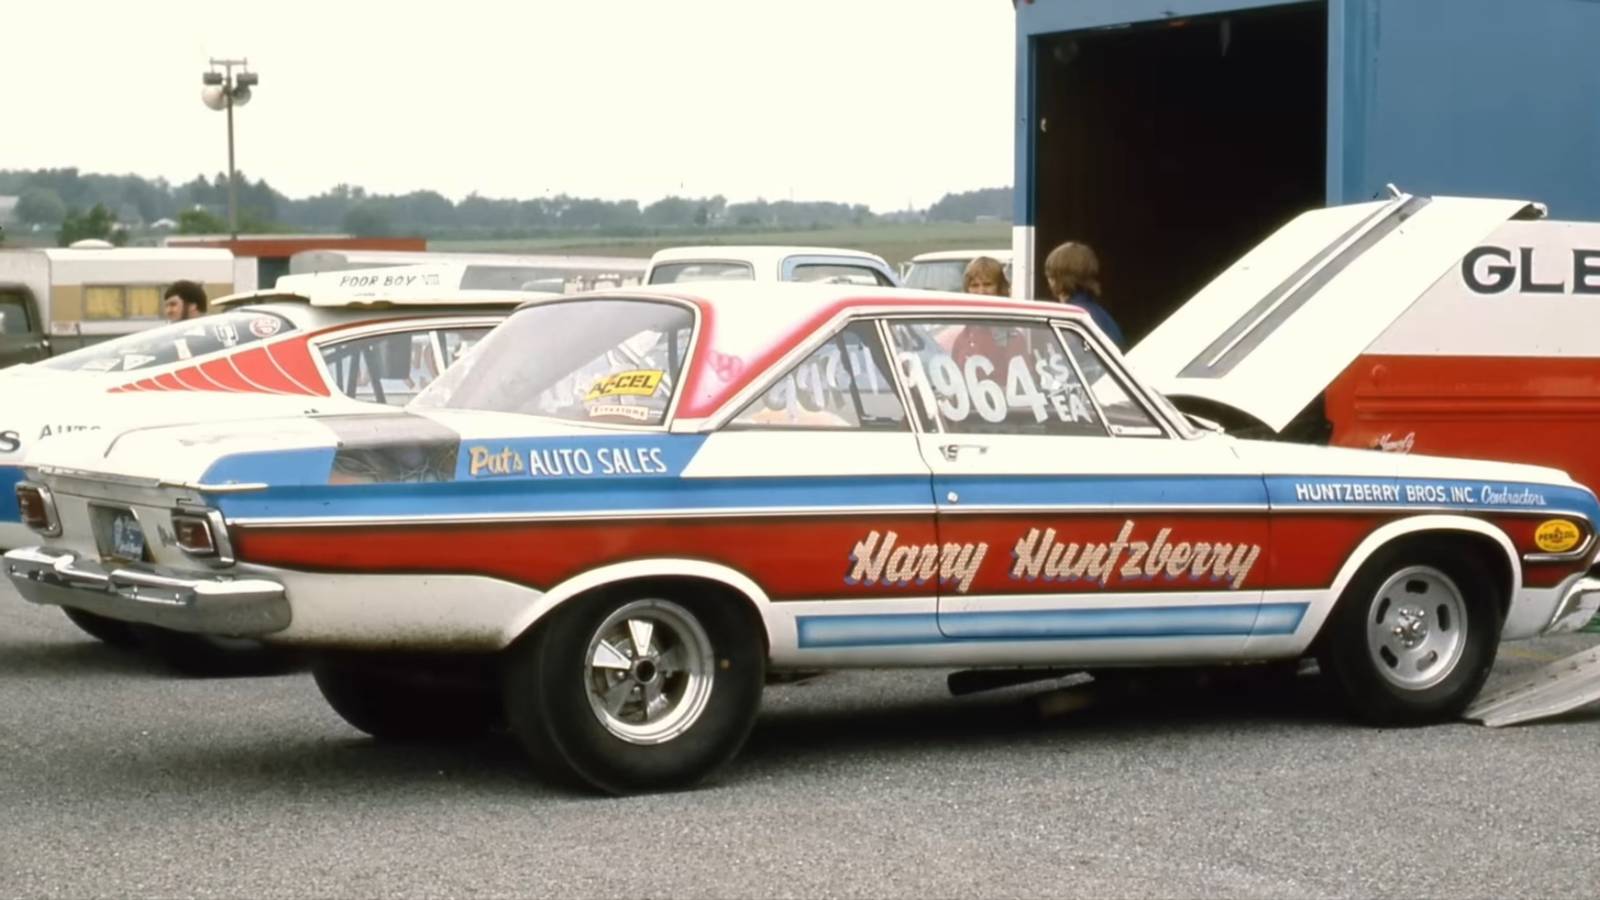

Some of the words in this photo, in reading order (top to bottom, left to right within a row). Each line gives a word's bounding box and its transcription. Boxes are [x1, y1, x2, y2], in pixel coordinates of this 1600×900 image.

[383, 275, 416, 287] BOY
[588, 374, 654, 395] ACCEL
[530, 448, 594, 476] AUTO
[597, 447, 668, 475] SALES
[1295, 483, 1401, 502] HUNTZBERRY
[848, 529, 989, 593] Harry
[1011, 519, 1262, 591] Huntzberry
